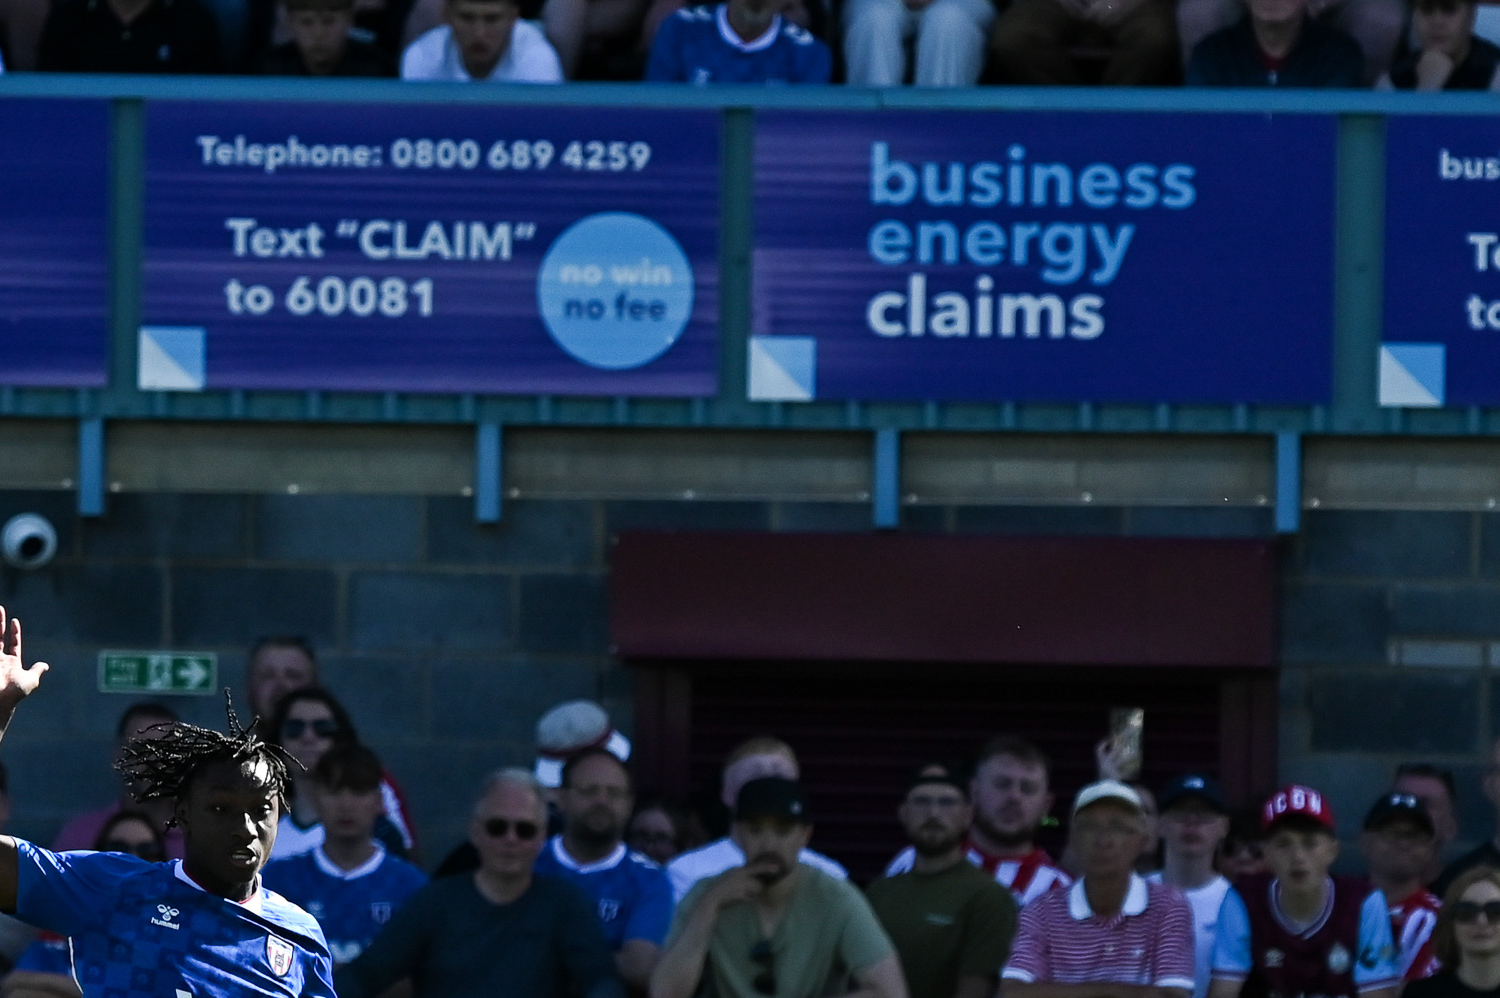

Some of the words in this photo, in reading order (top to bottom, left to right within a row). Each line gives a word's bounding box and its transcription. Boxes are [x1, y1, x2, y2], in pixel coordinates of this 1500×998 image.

[198, 135, 383, 173] Telephone:
[391, 139, 480, 170] 0800
[488, 140, 555, 170] 689
[562, 141, 652, 172] 4259
[870, 141, 1197, 209] business
[226, 217, 324, 259] Text
[868, 220, 1137, 286] energy
[560, 264, 602, 286] no
[609, 257, 673, 288] win
[226, 279, 274, 315] to
[287, 277, 435, 317] 60081
[565, 298, 604, 320] no
[614, 293, 667, 322] fee
[868, 273, 1105, 340] claims
[1263, 785, 1323, 821] ICON
[151, 917, 180, 930] hummel
